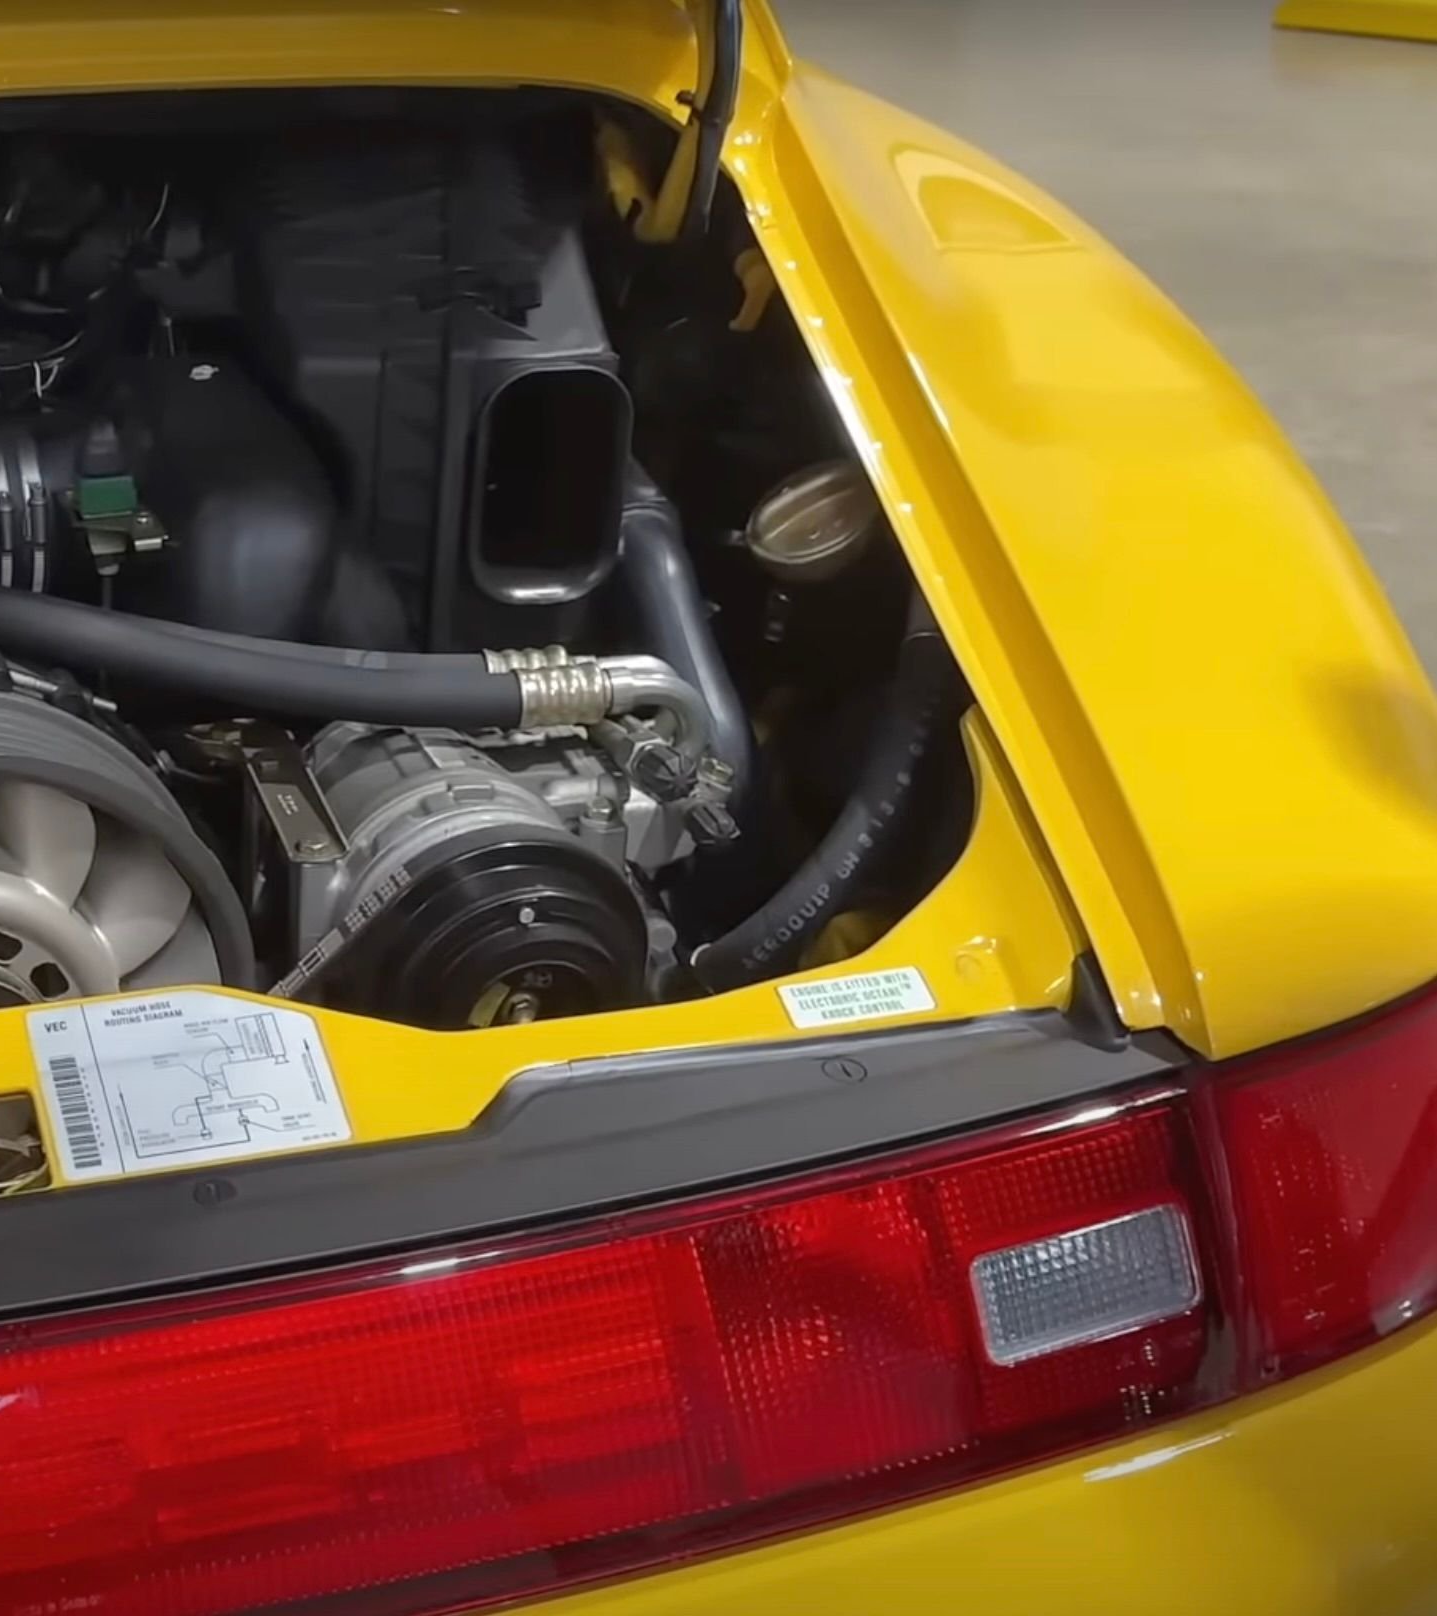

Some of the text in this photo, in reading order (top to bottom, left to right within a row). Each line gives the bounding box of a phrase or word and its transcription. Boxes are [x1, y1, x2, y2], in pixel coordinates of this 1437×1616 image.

[741, 882, 831, 971] AEROQUIP
[835, 851, 861, 880] GH
[789, 972, 910, 998] ENGINE IS FITTED WITH
[110, 1000, 171, 1017] VACUUM HOSE
[798, 995, 860, 1011] ELECTRONIC
[821, 1002, 905, 1020] KNOCK CONTROL
[44, 1020, 67, 1033] VEC
[103, 1009, 183, 1027] ROUTING DIAGRAM
